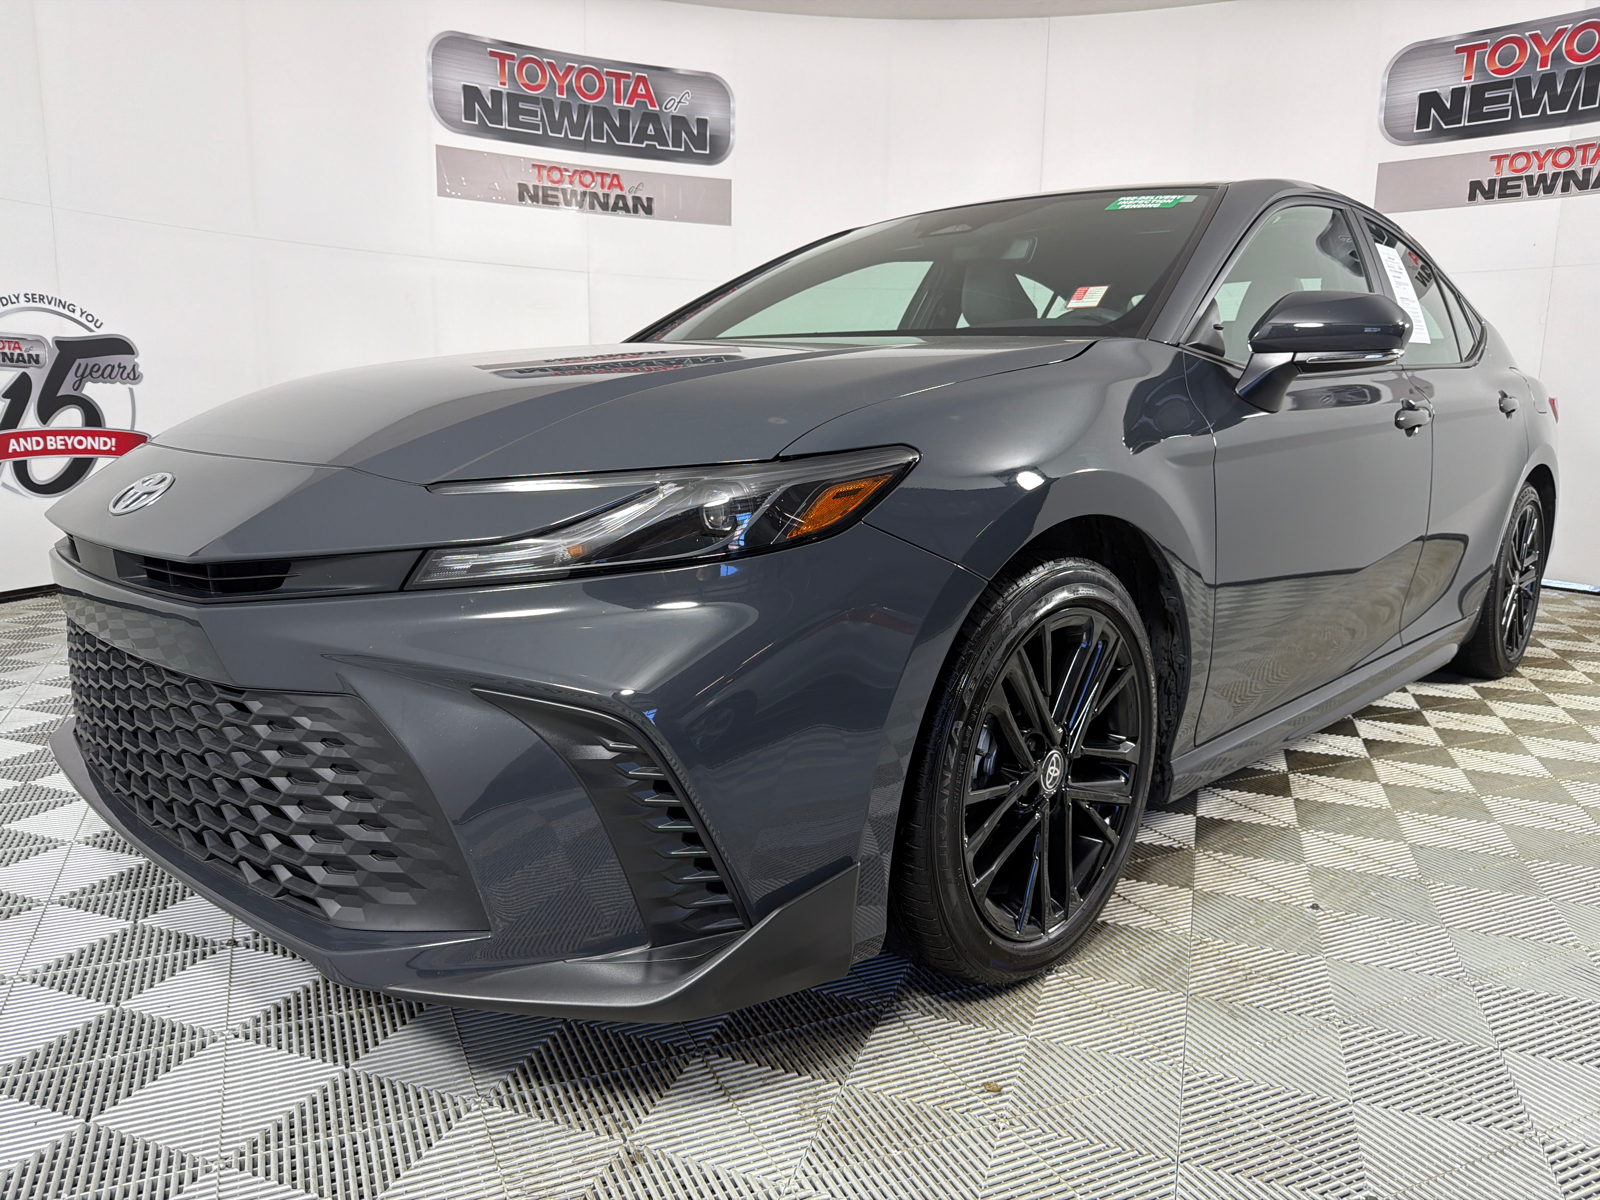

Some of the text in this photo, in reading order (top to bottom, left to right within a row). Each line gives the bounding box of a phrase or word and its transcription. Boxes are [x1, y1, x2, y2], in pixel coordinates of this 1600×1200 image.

[487, 48, 690, 112] TOYOTA of
[461, 83, 709, 153] NEWNAN
[531, 163, 624, 192] TOYOTA
[517, 182, 655, 216] NEWNAN
[24, 293, 76, 313] SERVING
[79, 308, 104, 329] YOU
[73, 362, 139, 392] years
[9, 437, 116, 453] AND BEYOND!
